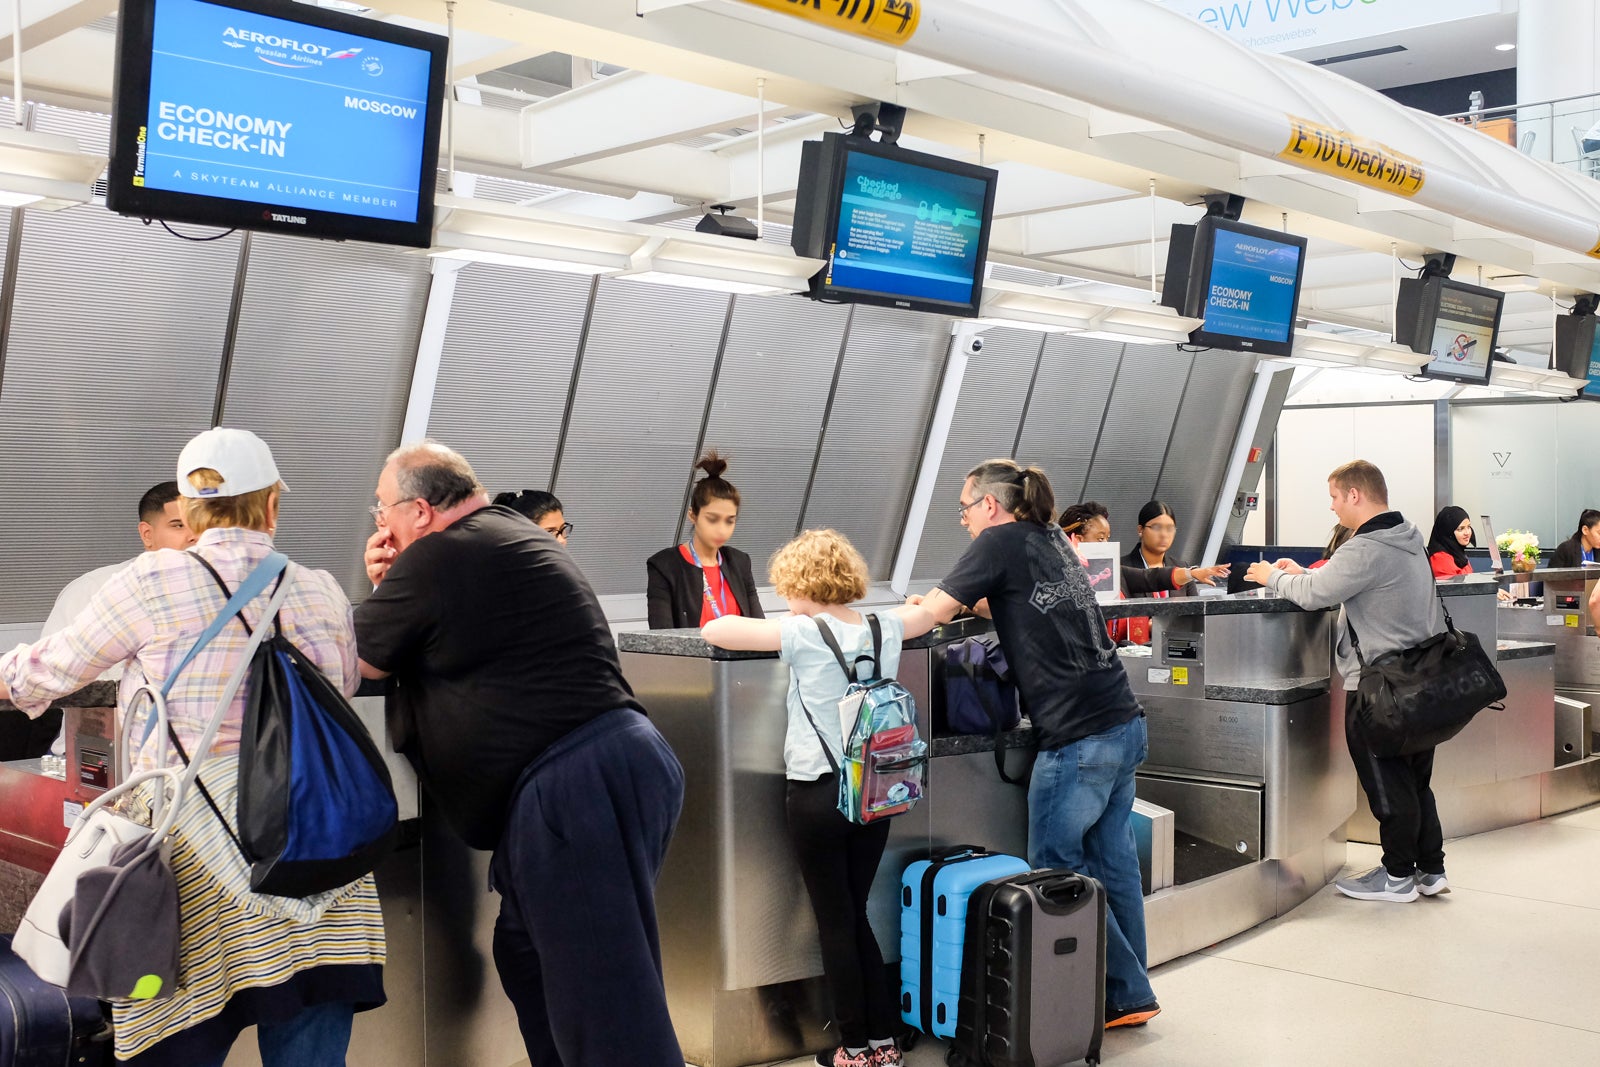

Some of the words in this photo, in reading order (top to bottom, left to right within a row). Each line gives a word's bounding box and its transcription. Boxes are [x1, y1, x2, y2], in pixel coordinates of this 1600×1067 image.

[1198, 0, 1252, 31] ew
[223, 27, 330, 58] AEROFLOT
[254, 46, 287, 60] Russian
[290, 53, 323, 67] Airlines
[344, 95, 417, 120] MOSCOW
[158, 102, 292, 139] ECONOMY
[157, 122, 286, 158] CHECK-IN
[1292, 126, 1307, 154] E
[1336, 138, 1407, 186] Check-in
[173, 169, 182, 179] A
[191, 172, 260, 189] SKYTEAM
[268, 183, 335, 200] ALLIANCE
[342, 194, 398, 208] MEMBER
[857, 175, 899, 193] Checked
[271, 213, 307, 225] TATUNG
[1235, 243, 1268, 255] AEROFLOT
[1269, 275, 1294, 285] MOSCOW
[1210, 295, 1250, 311] CHECK-IN
[1211, 285, 1252, 301] ECONOMY
